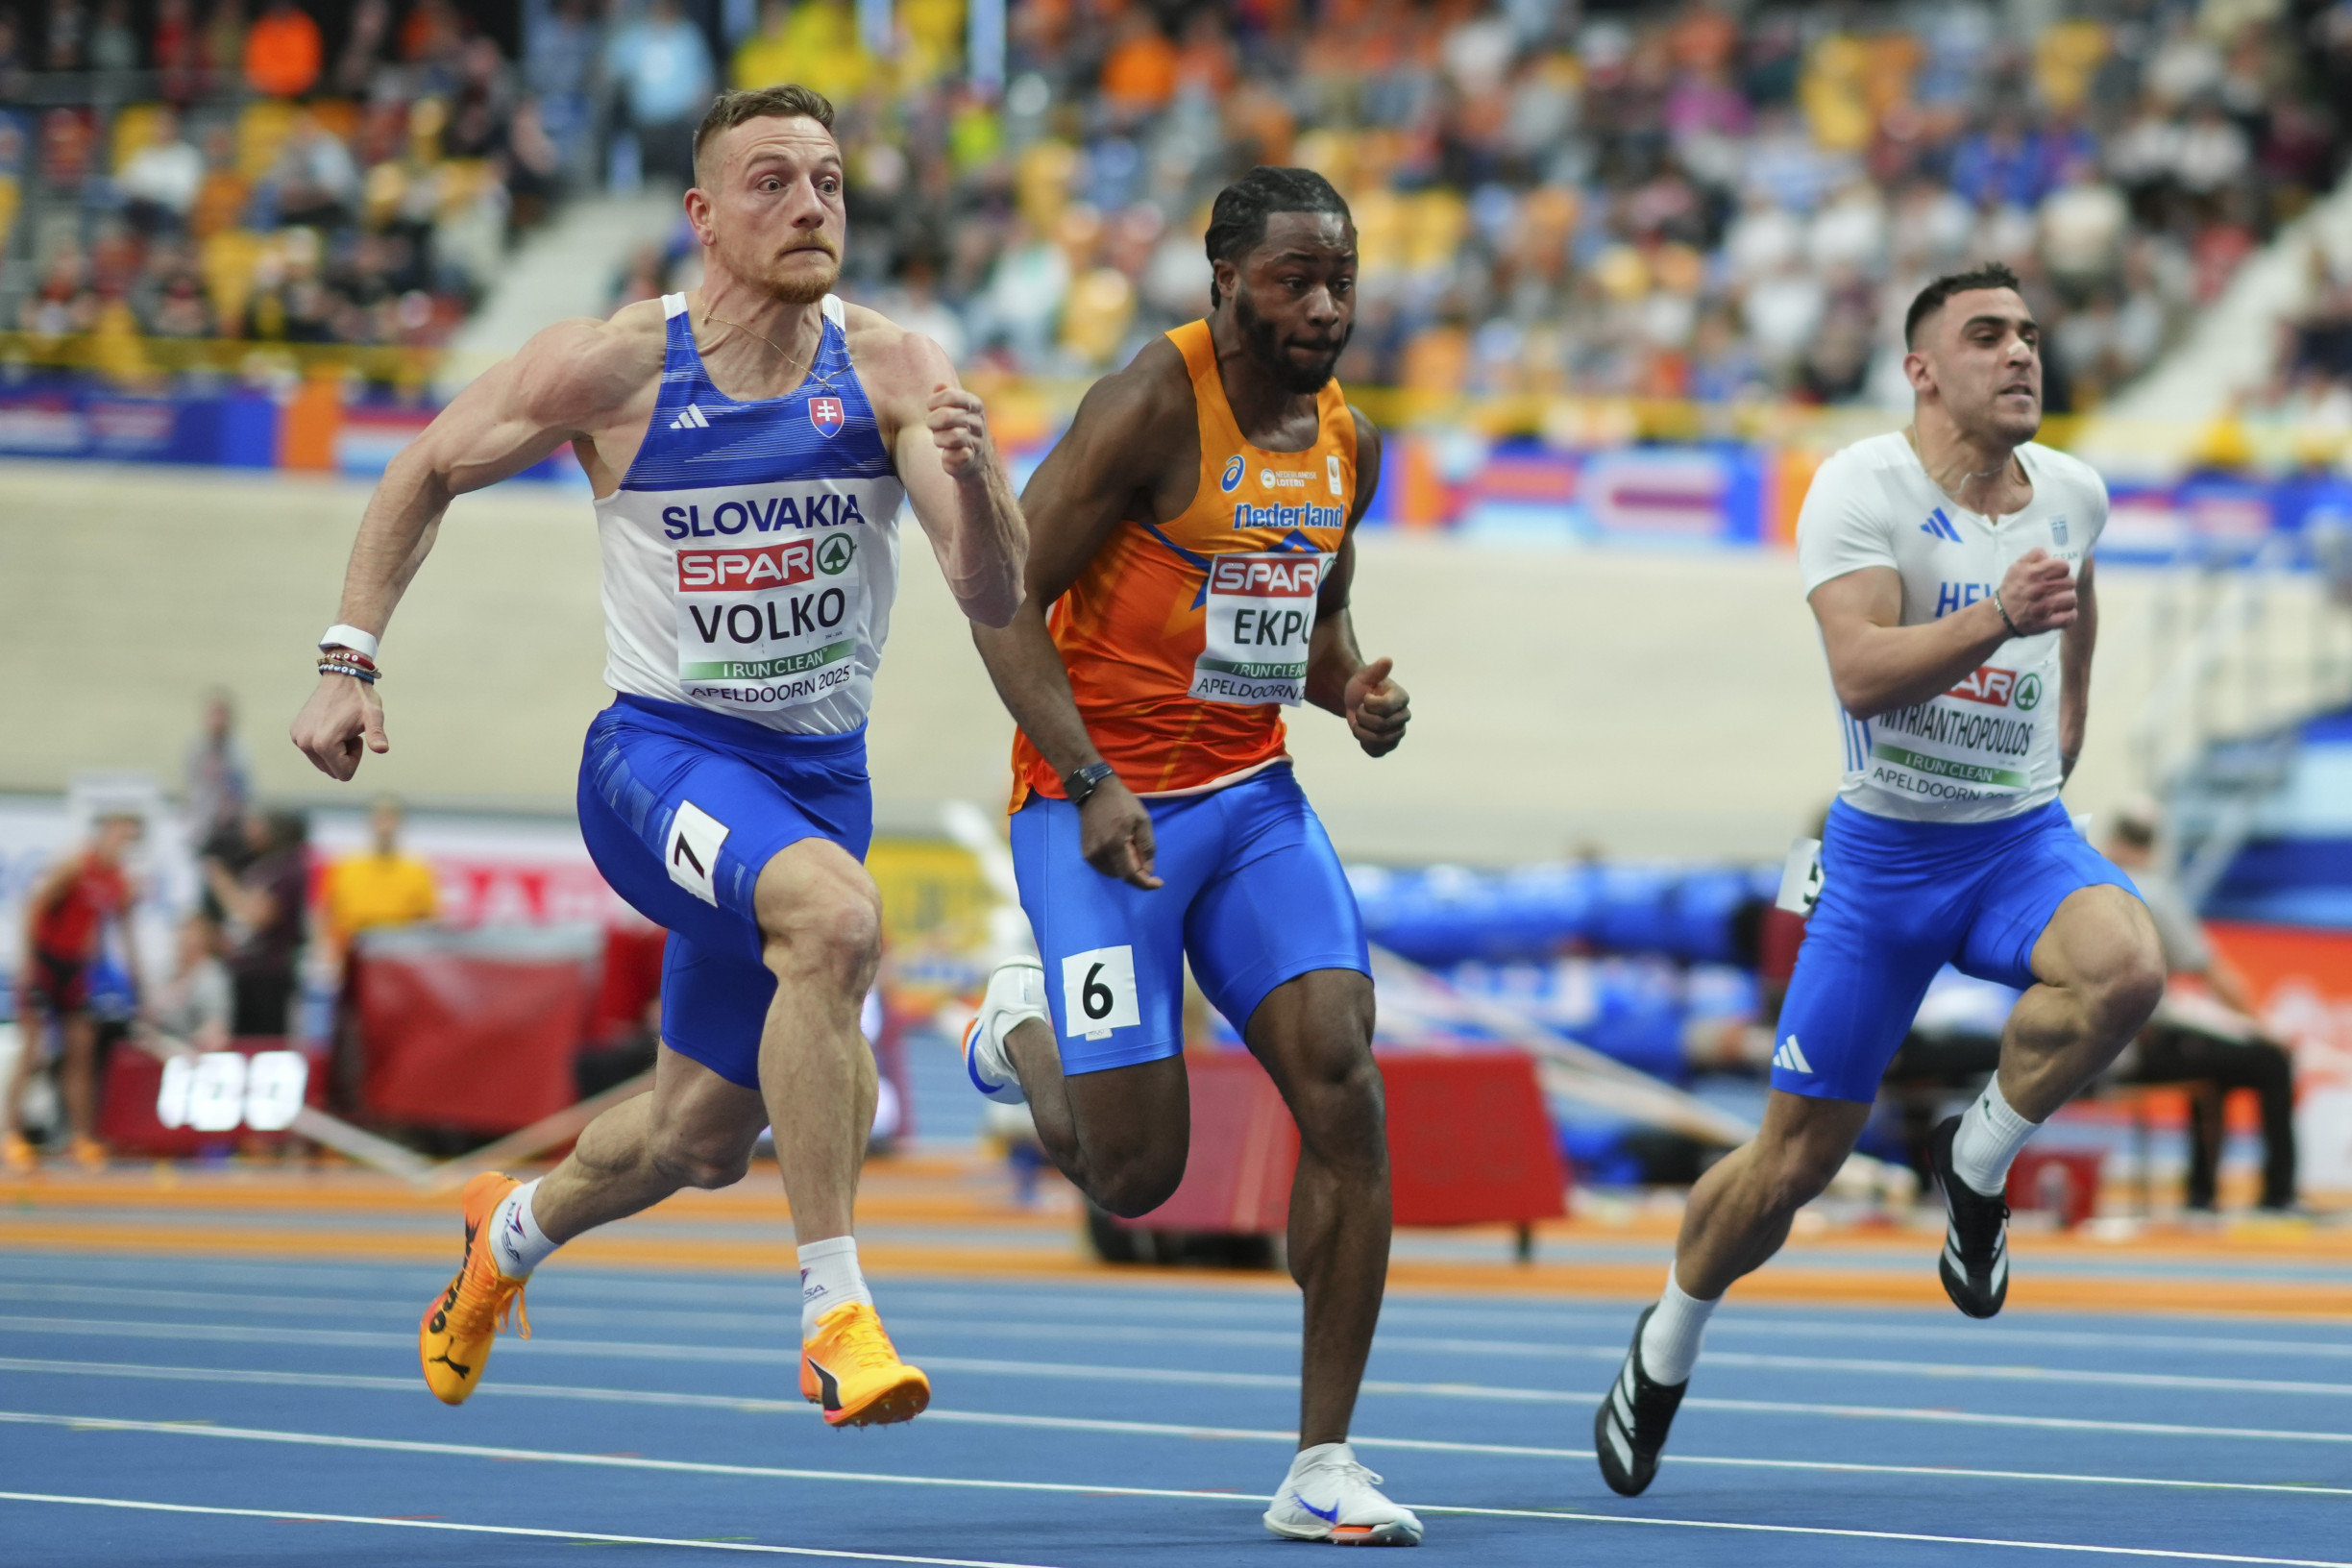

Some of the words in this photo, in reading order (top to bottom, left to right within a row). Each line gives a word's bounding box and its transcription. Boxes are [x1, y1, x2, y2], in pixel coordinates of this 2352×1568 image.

[662, 494, 865, 540] SLOVAKIA
[1233, 501, 1344, 529] Nederland
[682, 545, 810, 585] SPAR
[1215, 562, 1318, 593] SPAR
[689, 587, 845, 645] VOLKO
[691, 677, 816, 703] APELDOORN
[819, 664, 850, 691] 2025
[723, 663, 728, 677] I
[733, 662, 770, 677] RUN
[1239, 664, 1270, 677] RUN
[1196, 677, 1299, 700] APELDOORN
[1914, 754, 1947, 773] RUN
[1874, 767, 1981, 800] APELDOORN
[674, 830, 704, 880] 7
[1083, 962, 1114, 1019] 6
